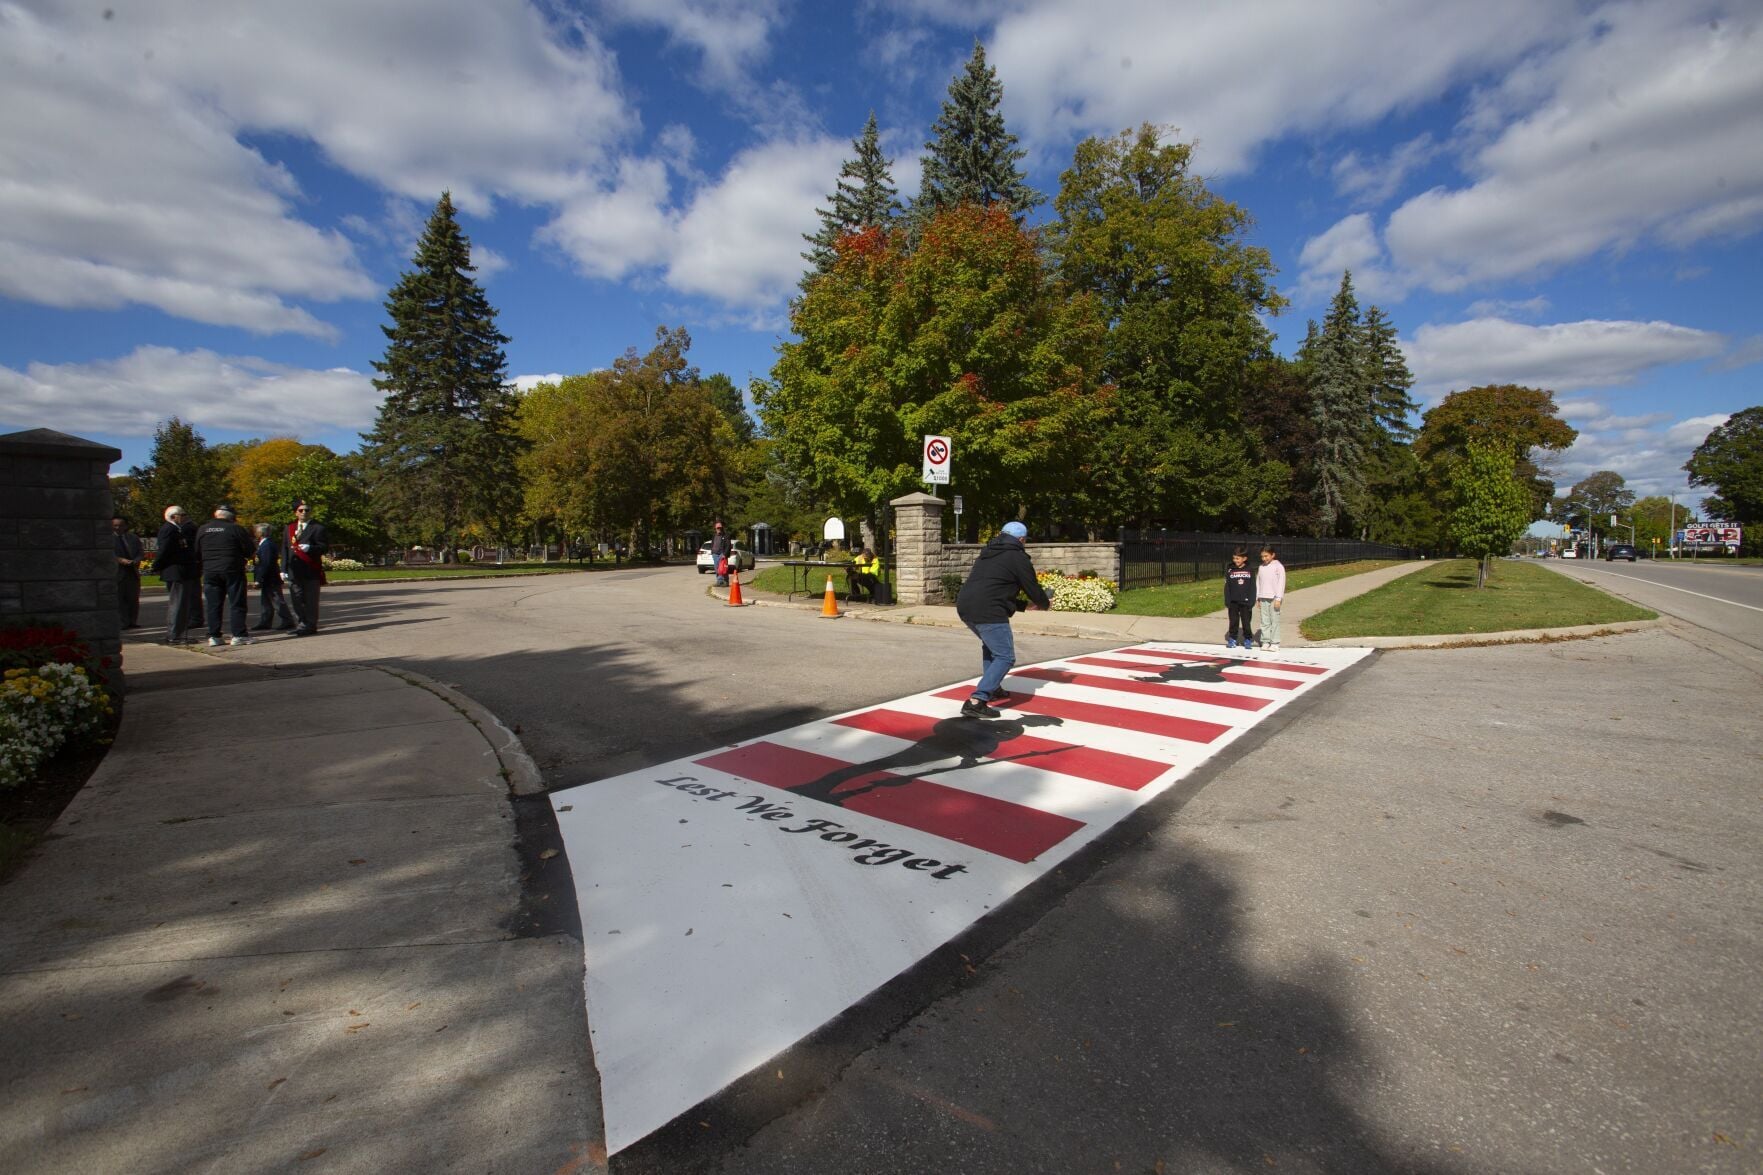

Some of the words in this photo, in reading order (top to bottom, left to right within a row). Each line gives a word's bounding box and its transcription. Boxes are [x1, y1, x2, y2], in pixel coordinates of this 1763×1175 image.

[655, 775, 737, 801] Lest
[735, 795, 794, 821] We
[779, 818, 969, 880] Forget
